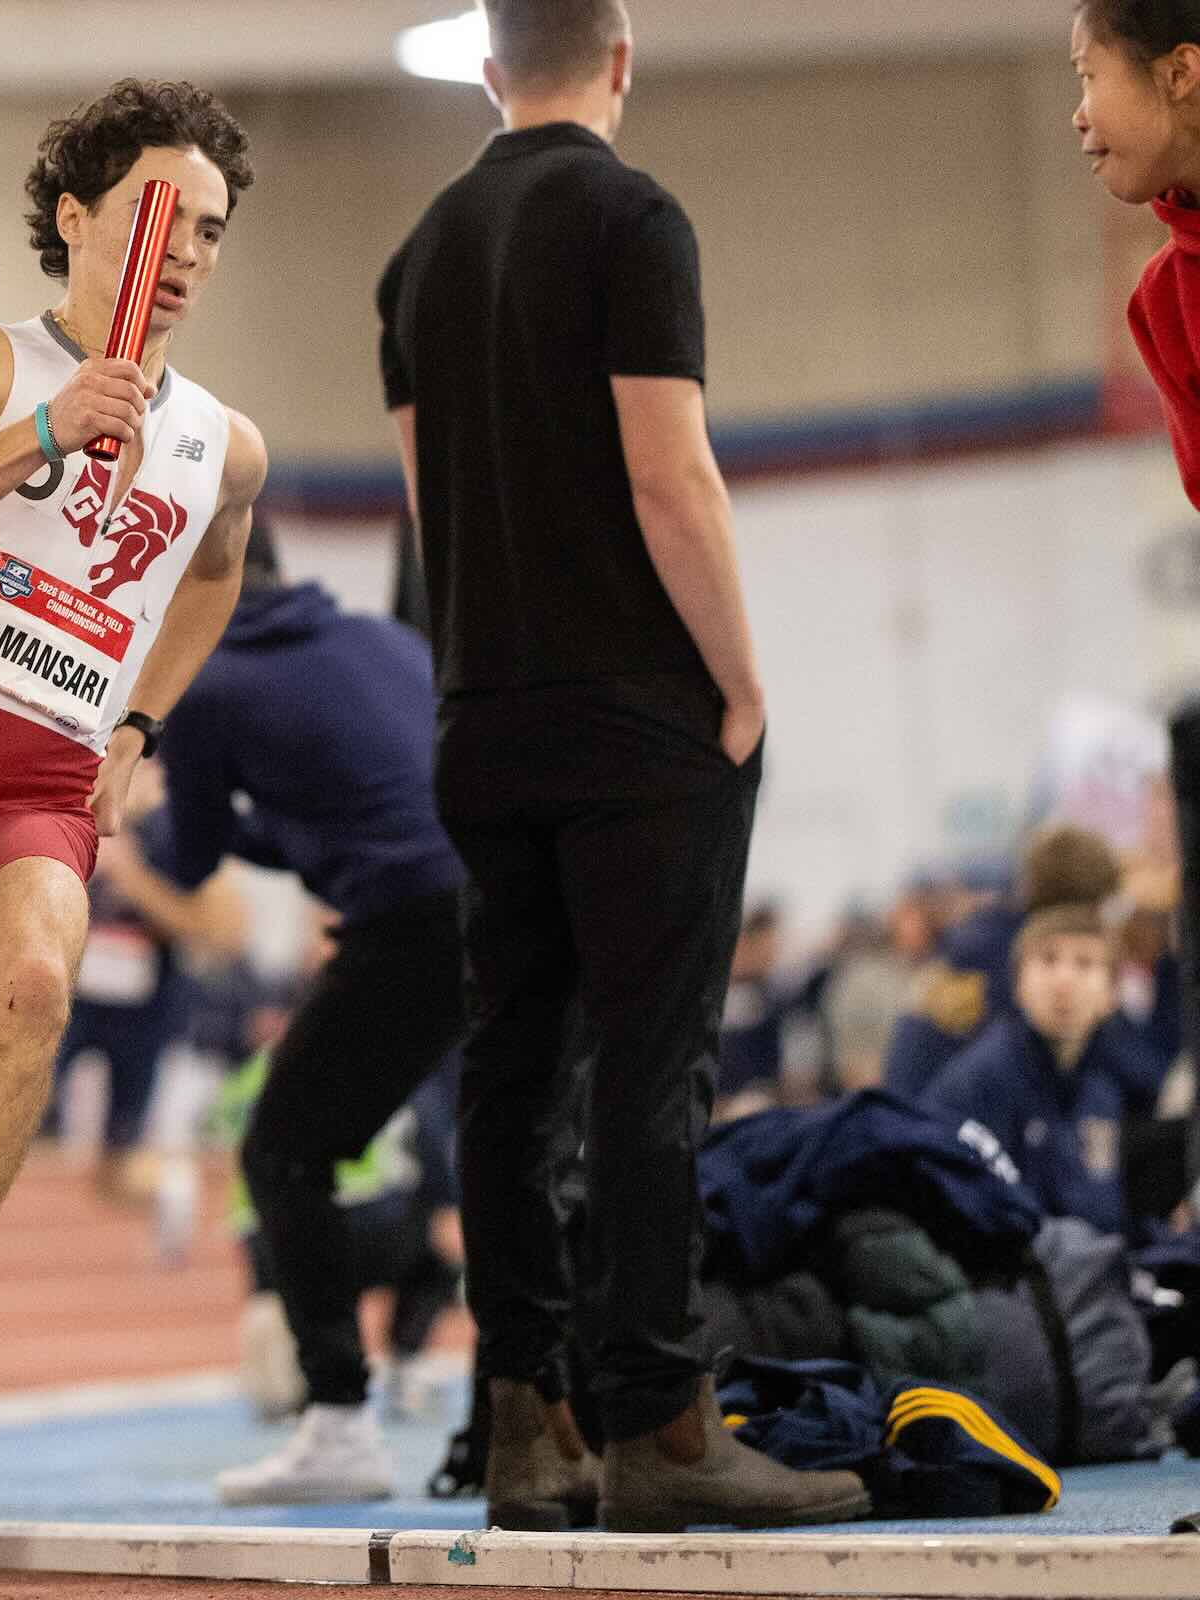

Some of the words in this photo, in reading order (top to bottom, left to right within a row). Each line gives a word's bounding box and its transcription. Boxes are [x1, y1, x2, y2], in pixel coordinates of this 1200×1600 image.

[46, 599, 107, 638] CHAMPIONSHIPS
[74, 598, 97, 620] TRACK
[97, 611, 105, 623] &
[104, 617, 123, 633] FIELD
